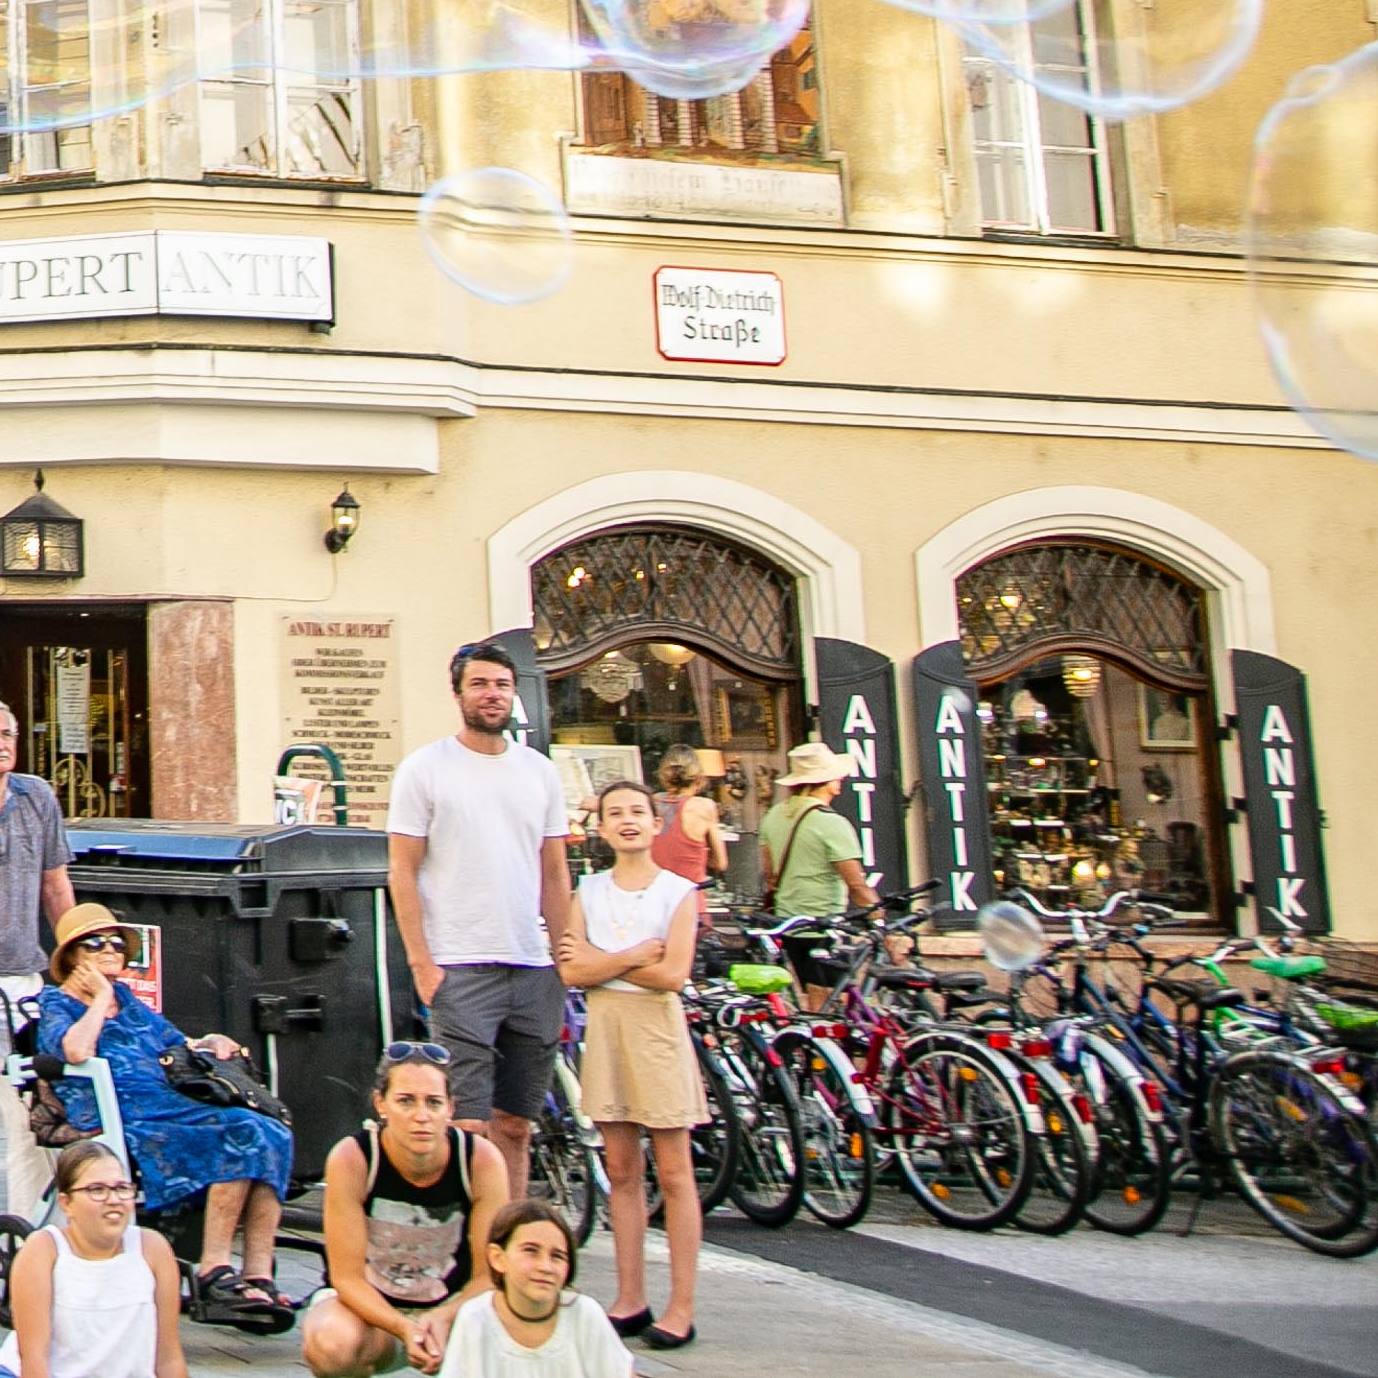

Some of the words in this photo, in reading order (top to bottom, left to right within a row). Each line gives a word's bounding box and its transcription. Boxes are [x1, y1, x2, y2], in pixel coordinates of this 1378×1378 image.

[161, 250, 321, 300] ANTIK
[683, 315, 762, 348] Straße
[935, 695, 979, 911] ANTIK
[1260, 705, 1309, 917] ANTIK
